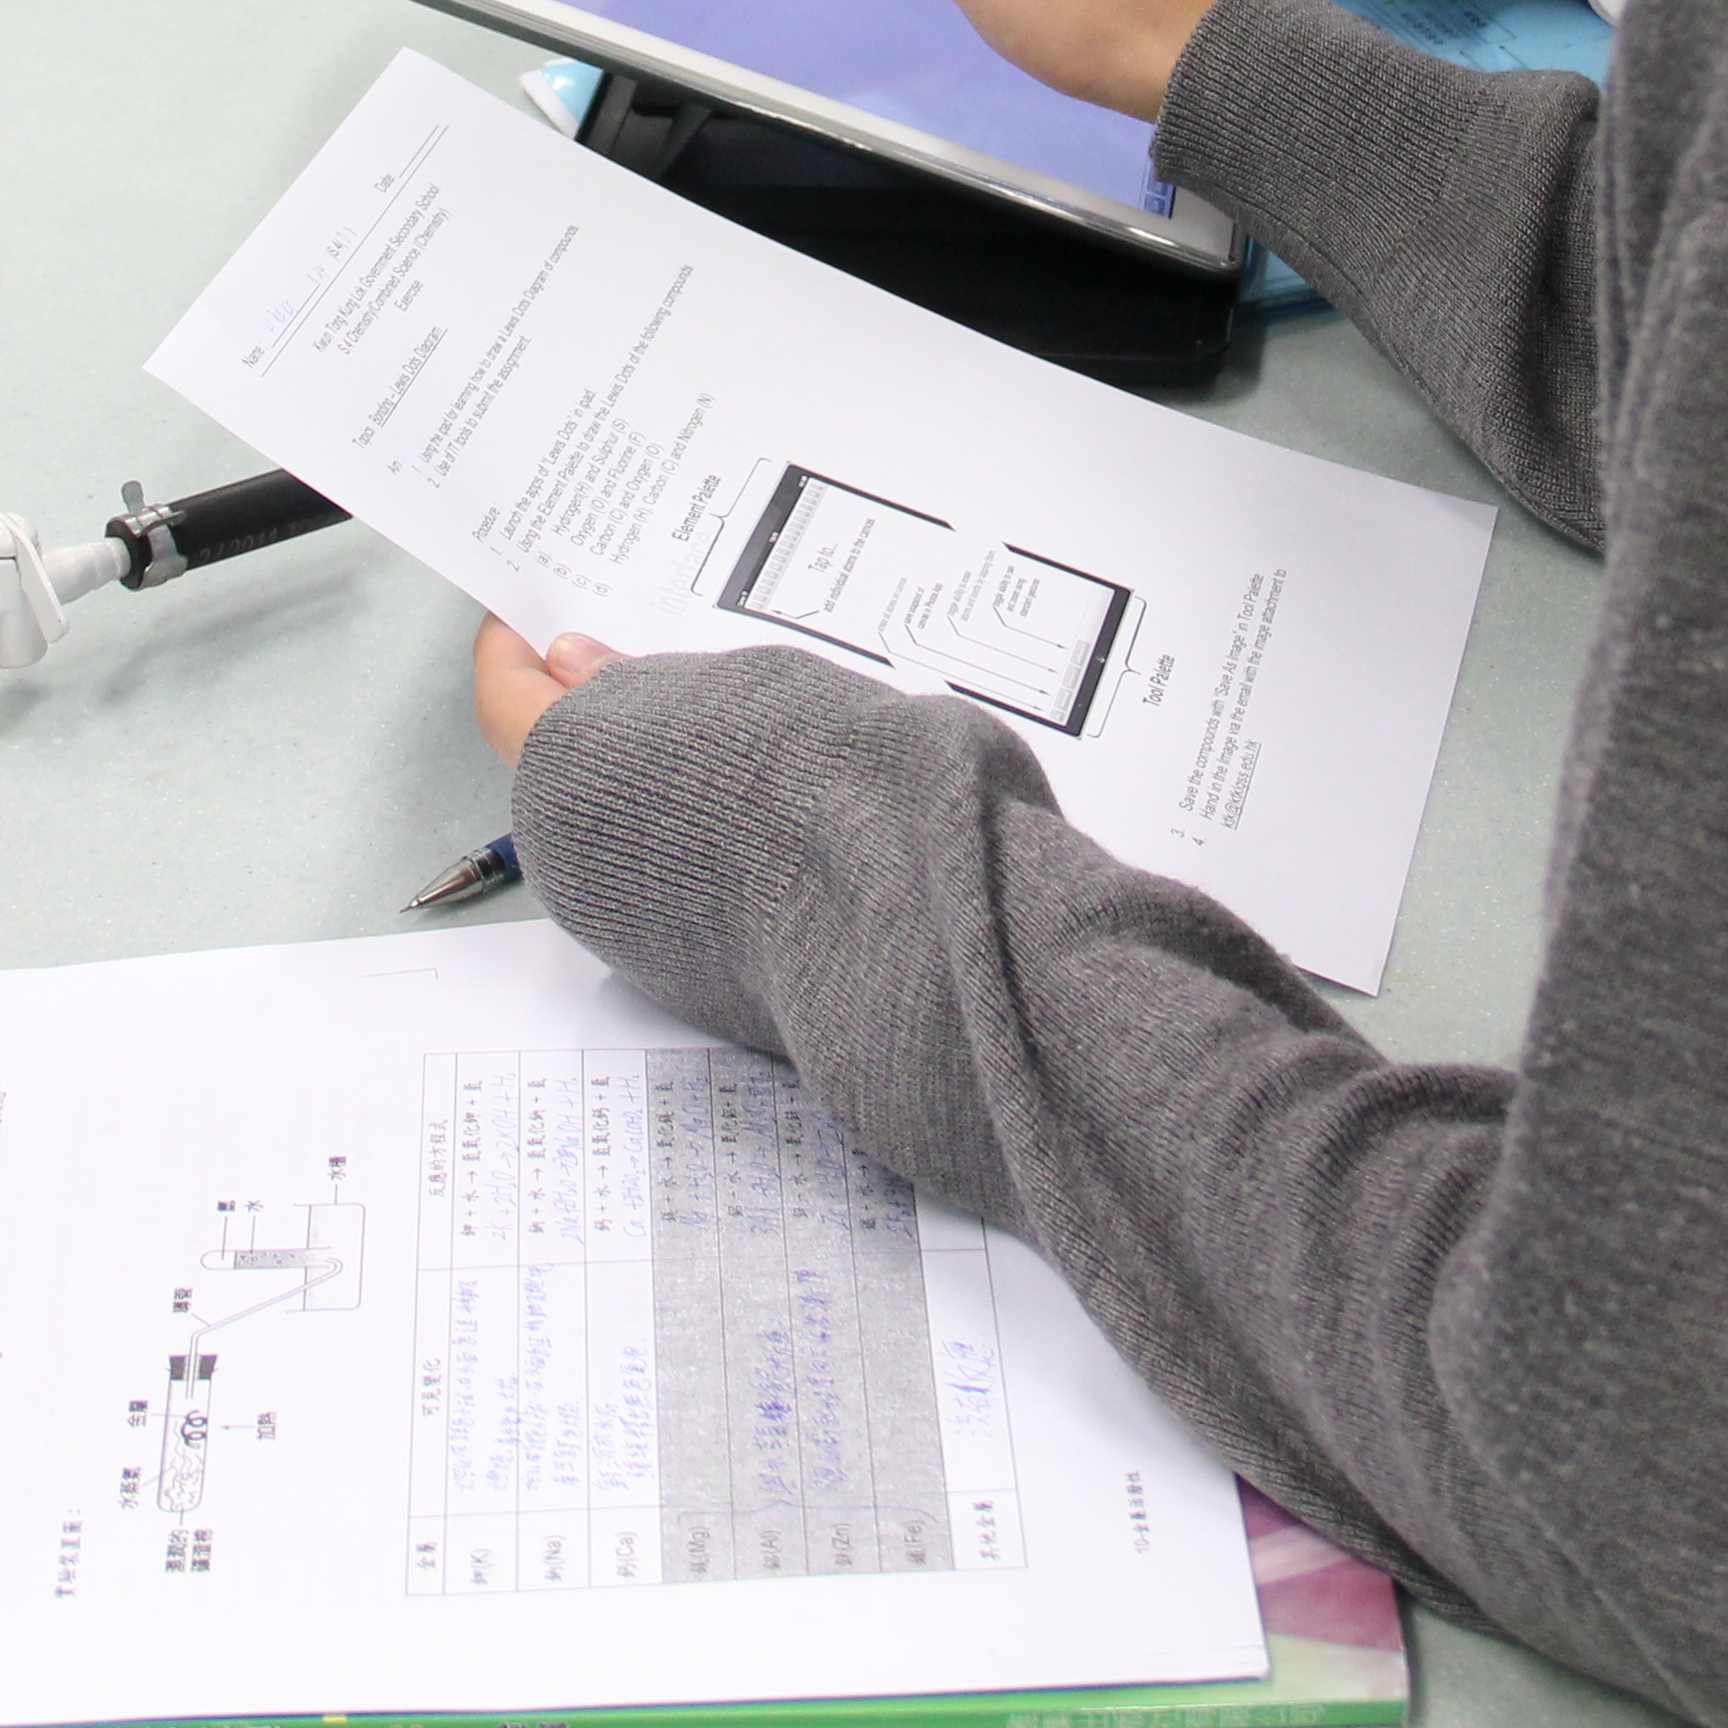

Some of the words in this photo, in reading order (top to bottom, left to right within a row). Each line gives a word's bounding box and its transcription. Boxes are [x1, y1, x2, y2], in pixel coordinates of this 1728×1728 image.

[411, 181, 442, 212] School
[385, 206, 427, 249] Secondary
[390, 245, 423, 279] Science
[409, 204, 453, 252] (Chemistry)
[356, 242, 399, 289] Government
[346, 283, 369, 302] Lok
[391, 277, 425, 313] Exercise
[520, 267, 552, 302] Diagram
[658, 262, 697, 310] compounds
[334, 296, 363, 320] Kung
[509, 296, 533, 318] Dots
[322, 312, 351, 335] Tong
[496, 313, 522, 338] Lewis
[636, 304, 673, 343] following
[309, 329, 336, 354] Kwun
[411, 323, 448, 361] Diagram
[482, 338, 505, 361] draw
[629, 338, 650, 356] the
[399, 353, 425, 376] Dots
[466, 364, 488, 384] how
[612, 361, 637, 385] Dots
[387, 370, 414, 396] Lewis
[448, 379, 481, 413] learning
[598, 380, 626, 409] Lewis
[365, 394, 399, 428] Bonding
[441, 405, 461, 422] for
[590, 404, 612, 423] the
[607, 415, 632, 436] (S)
[674, 405, 708, 445] Nitrogen
[426, 431, 445, 448] the
[431, 457, 453, 478] Use
[450, 424, 475, 448] tools
[468, 389, 497, 421] submit
[484, 376, 505, 395] the
[579, 417, 604, 444] draw
[415, 441, 441, 465] Using
[573, 438, 592, 453] to
[589, 429, 623, 467] Sulphur
[666, 439, 688, 461] and
[554, 448, 586, 483] Palette
[580, 460, 603, 484] and
[604, 442, 639, 482] Fluorine
[623, 455, 657, 493] Oxygen
[534, 476, 569, 517] Element
[597, 475, 619, 499] and
[615, 487, 637, 511] and
[639, 471, 671, 507] Carbon
[496, 508, 526, 542] Launch
[512, 494, 534, 514] the
[523, 474, 548, 501] apps
[526, 511, 548, 532] the
[669, 499, 707, 544] Element
[689, 471, 722, 505] Palette
[513, 526, 543, 555] Using
[567, 509, 602, 548] Oxygen
[587, 520, 620, 558] Carbon
[606, 519, 646, 567] Hydrogen
[805, 553, 835, 576] Tap
[1271, 565, 1289, 580] to
[826, 569, 850, 602] individual
[1240, 570, 1266, 605] Palette
[1234, 599, 1256, 623] Tool
[1258, 575, 1286, 626] attachment
[1250, 621, 1274, 653] image
[1147, 651, 1177, 688] Palette
[1219, 658, 1238, 676] As
[1244, 647, 1264, 667] the
[1240, 662, 1259, 685] with
[1139, 681, 1166, 709] Tool
[1207, 695, 1227, 719] with
[1233, 679, 1254, 709] email
[1225, 719, 1242, 737] via
[1227, 704, 1247, 724] the
[1191, 714, 1223, 771] compounds
[1214, 733, 1241, 768] Image
[1185, 766, 1205, 788] the
[1205, 779, 1224, 795] in
[1209, 762, 1229, 784] the
[1176, 783, 1200, 813] Save
[1197, 789, 1221, 822] Hand
[326, 1154, 348, 1181] 水槽
[426, 1117, 449, 1199] 反應的方程式
[242, 1197, 265, 1213] 水
[170, 1286, 194, 1314] 導管
[419, 1356, 443, 1418] 可見變化
[125, 1398, 149, 1428] 金屬
[254, 1410, 278, 1441] 加熱
[117, 1464, 143, 1510] 水蒸氣
[970, 1498, 1001, 1561] 其他金屬
[414, 1539, 438, 1571] 金屬
